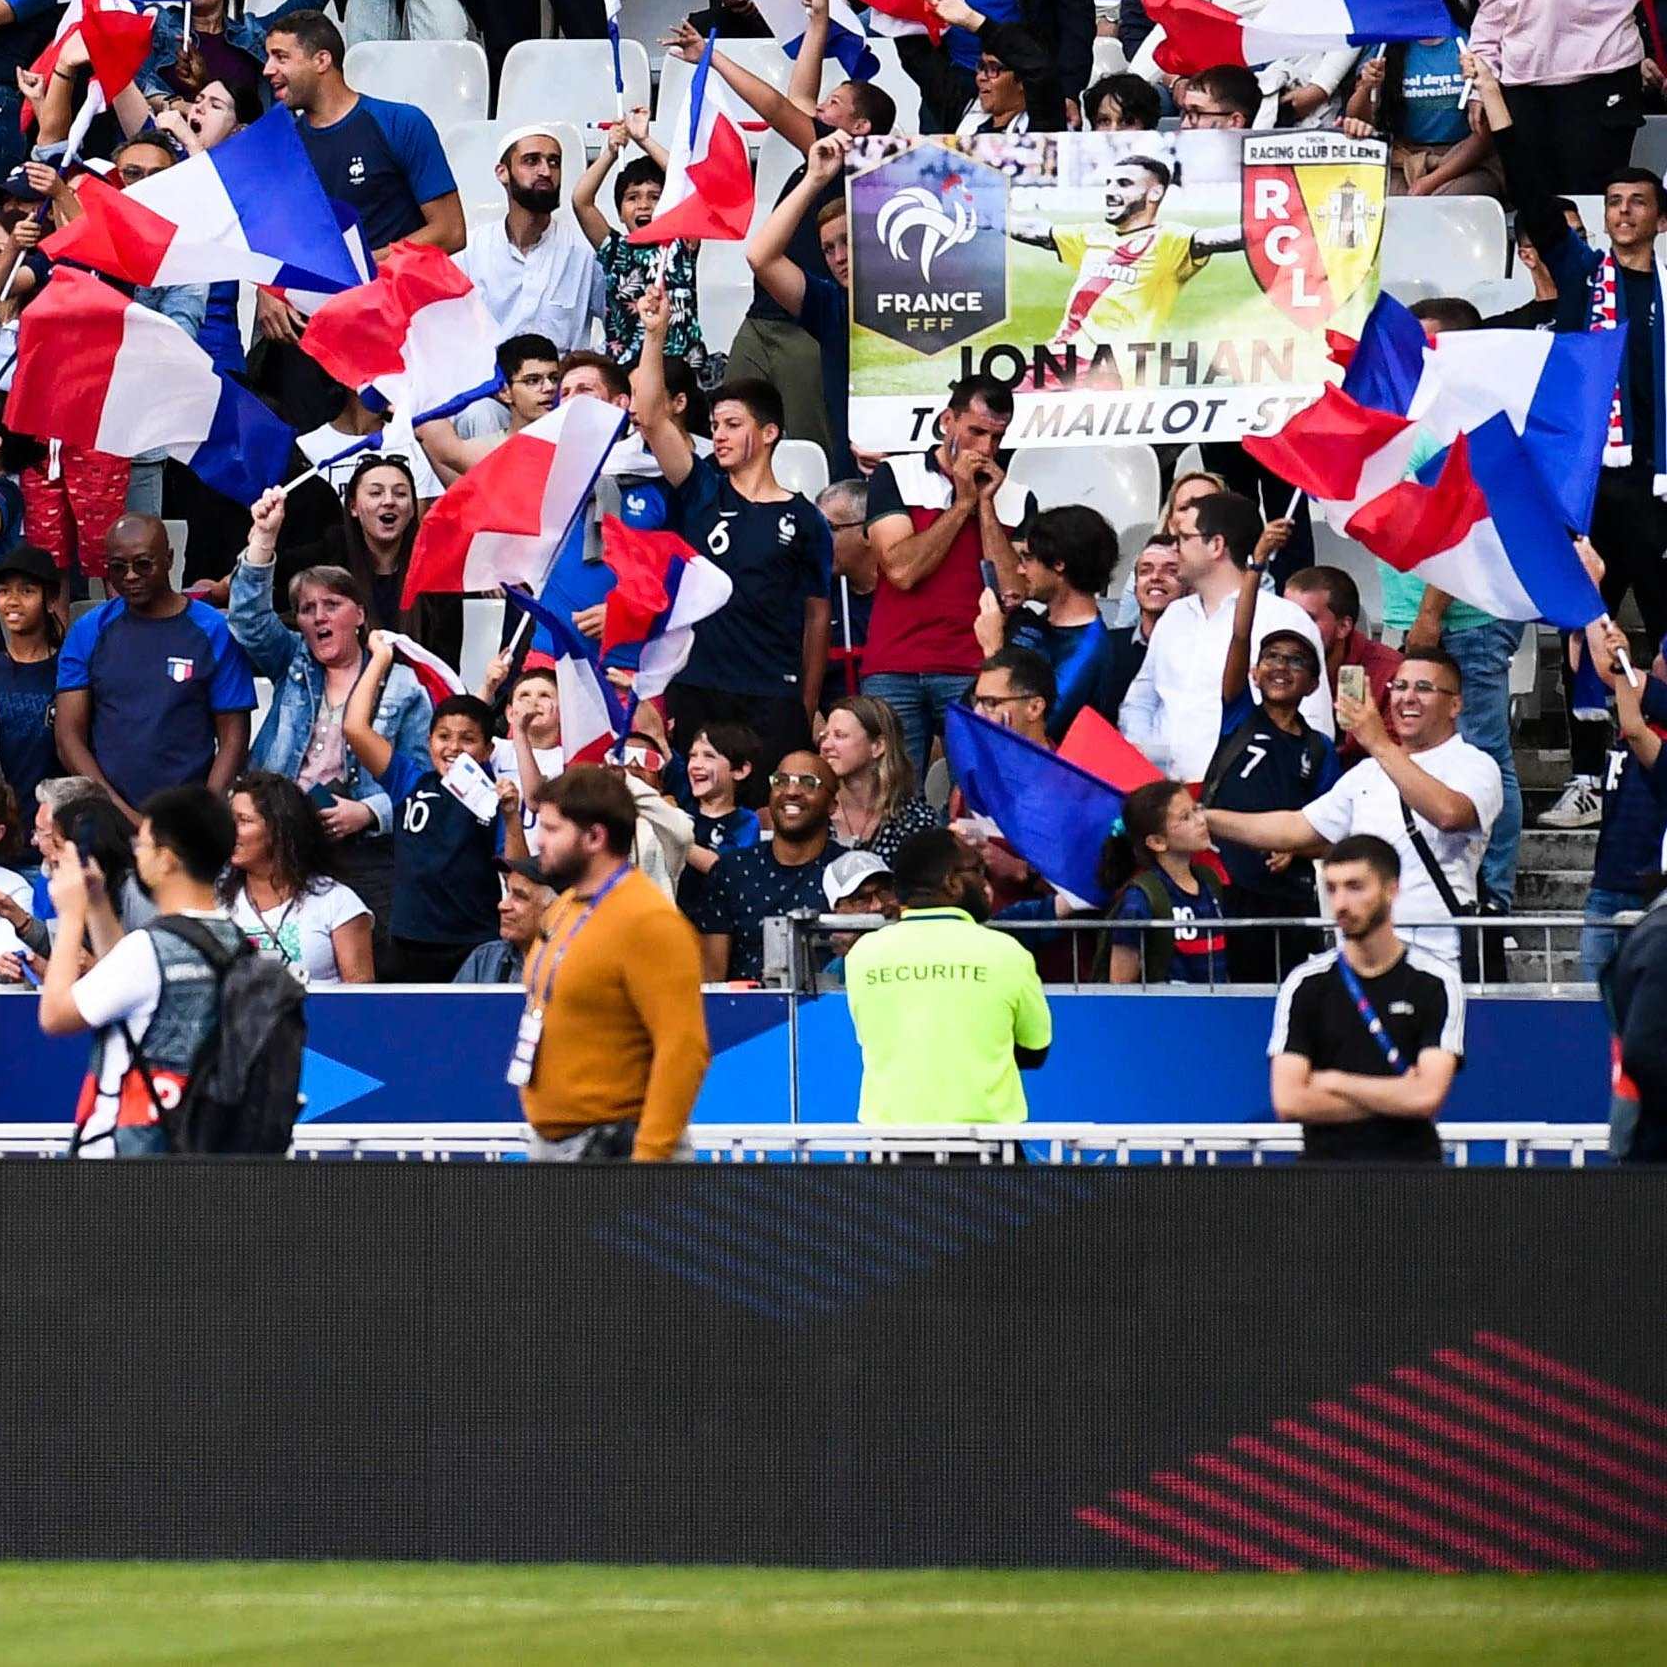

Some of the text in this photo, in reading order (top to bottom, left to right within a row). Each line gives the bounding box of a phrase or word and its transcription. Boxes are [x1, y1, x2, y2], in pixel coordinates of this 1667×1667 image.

[1250, 144, 1382, 161] RACING CLUB DE LENS
[877, 291, 983, 313] FRANCE
[906, 317, 954, 333] FFF
[949, 337, 1296, 390] JONATHAN
[1021, 399, 1227, 440] MAILLOT
[707, 519, 731, 556] 6
[1239, 744, 1268, 779] 7
[403, 796, 430, 833] 10
[866, 964, 989, 987] SECURITE
